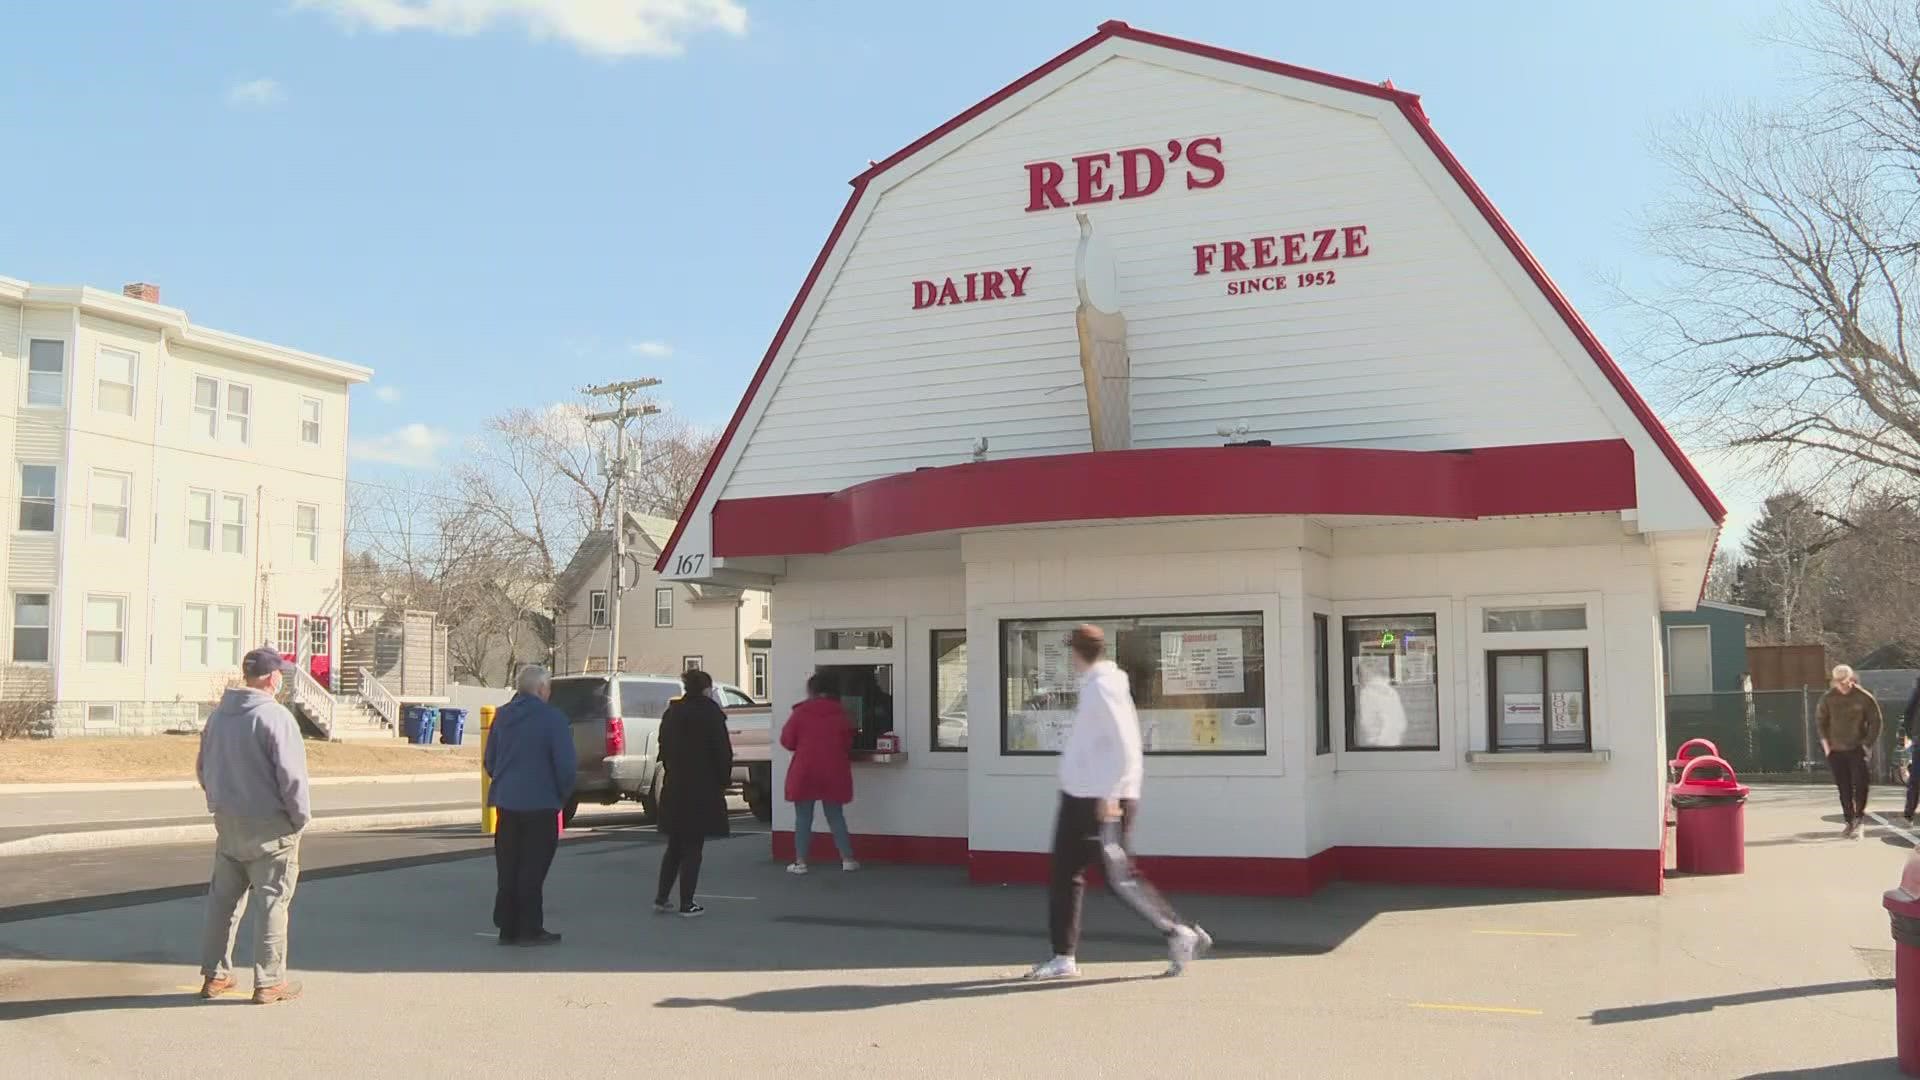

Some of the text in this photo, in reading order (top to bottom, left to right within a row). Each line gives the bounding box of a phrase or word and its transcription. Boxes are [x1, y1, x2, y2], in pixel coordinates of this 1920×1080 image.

[1025, 137, 1225, 212] RED'S
[1194, 226, 1369, 276] FREEZE
[913, 267, 1031, 309] DAIRY
[1227, 270, 1336, 296] SINCE 1952
[675, 554, 705, 575] 167
